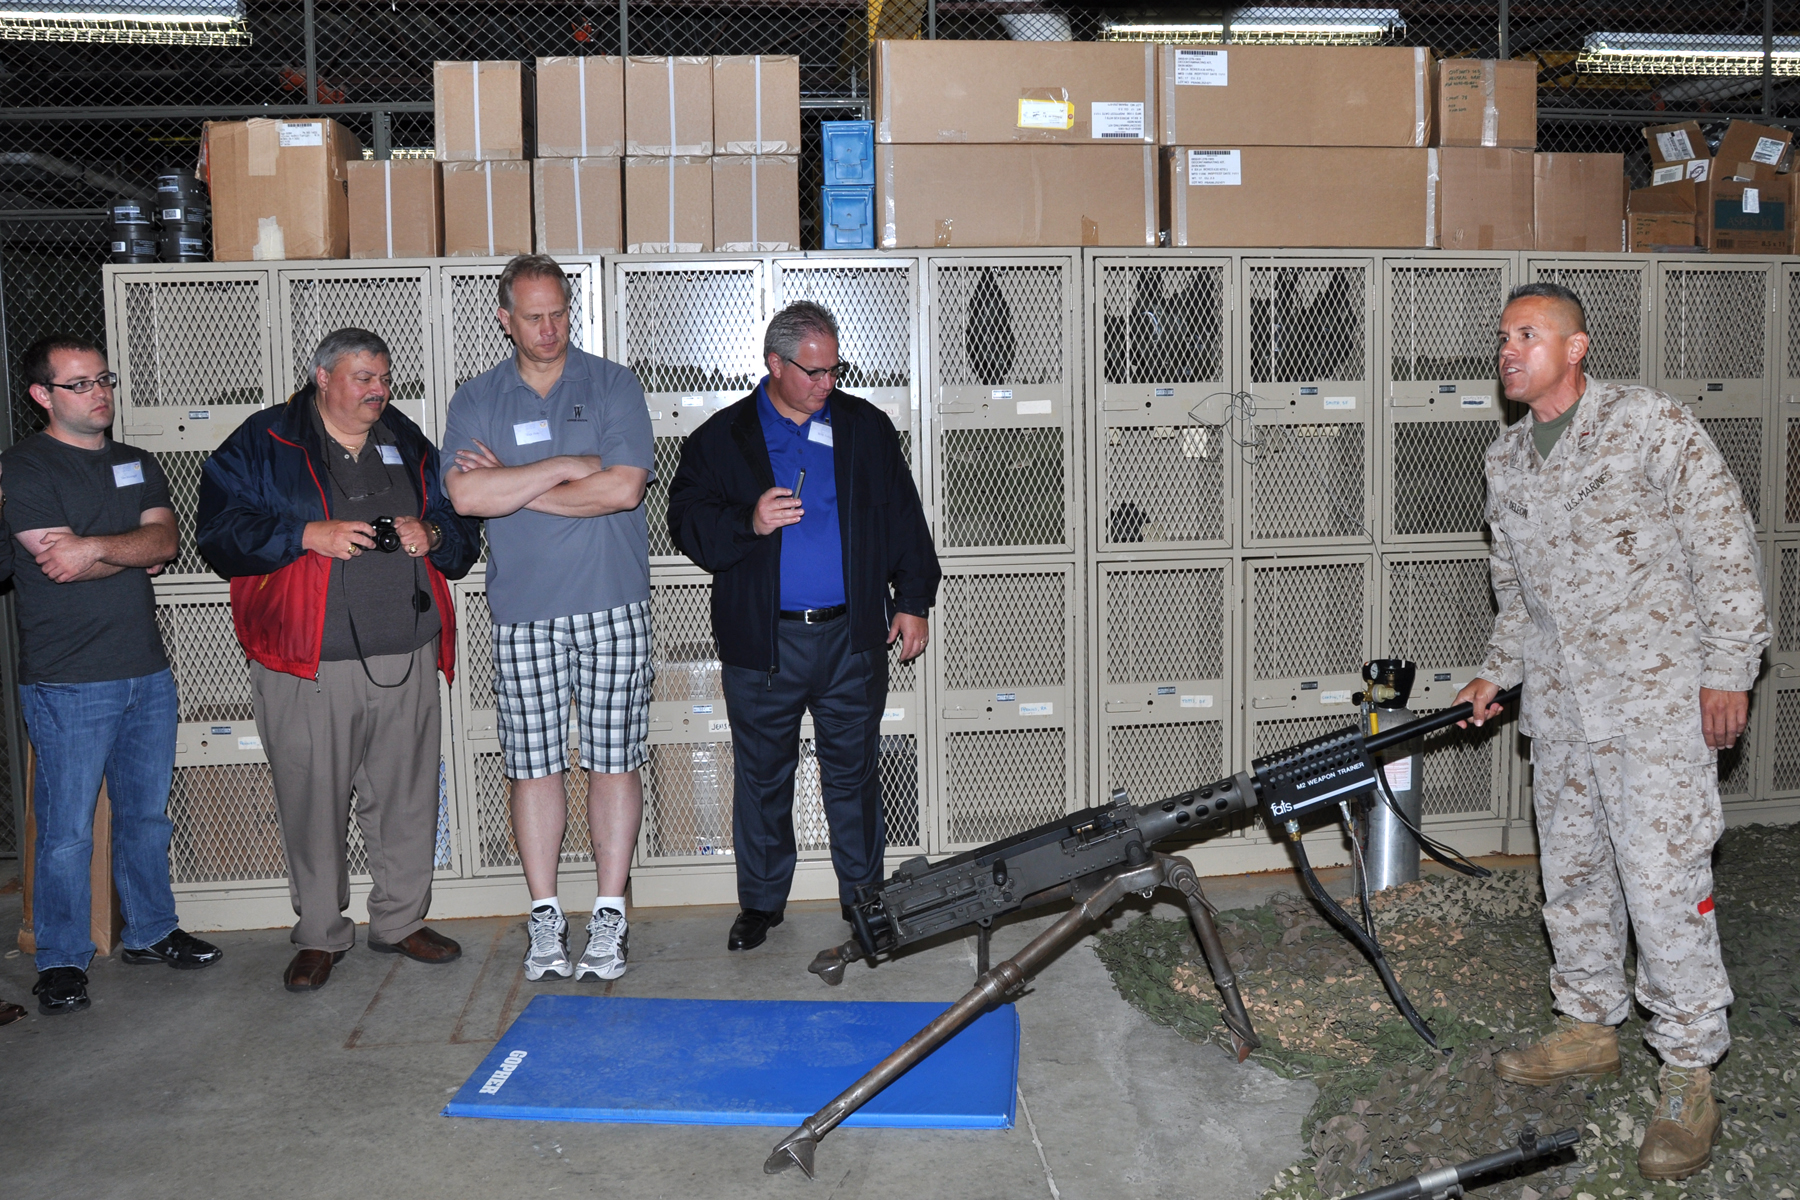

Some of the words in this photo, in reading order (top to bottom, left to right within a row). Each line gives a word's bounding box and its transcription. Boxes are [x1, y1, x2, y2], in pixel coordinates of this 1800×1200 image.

[1728, 216, 1758, 226] ASPEN
[1577, 470, 1613, 501] MARINES
[1296, 782, 1307, 790] M2
[1307, 772, 1336, 786] WEAPON
[1337, 761, 1365, 776] TRAINER
[478, 1050, 528, 1095] GOPHER
